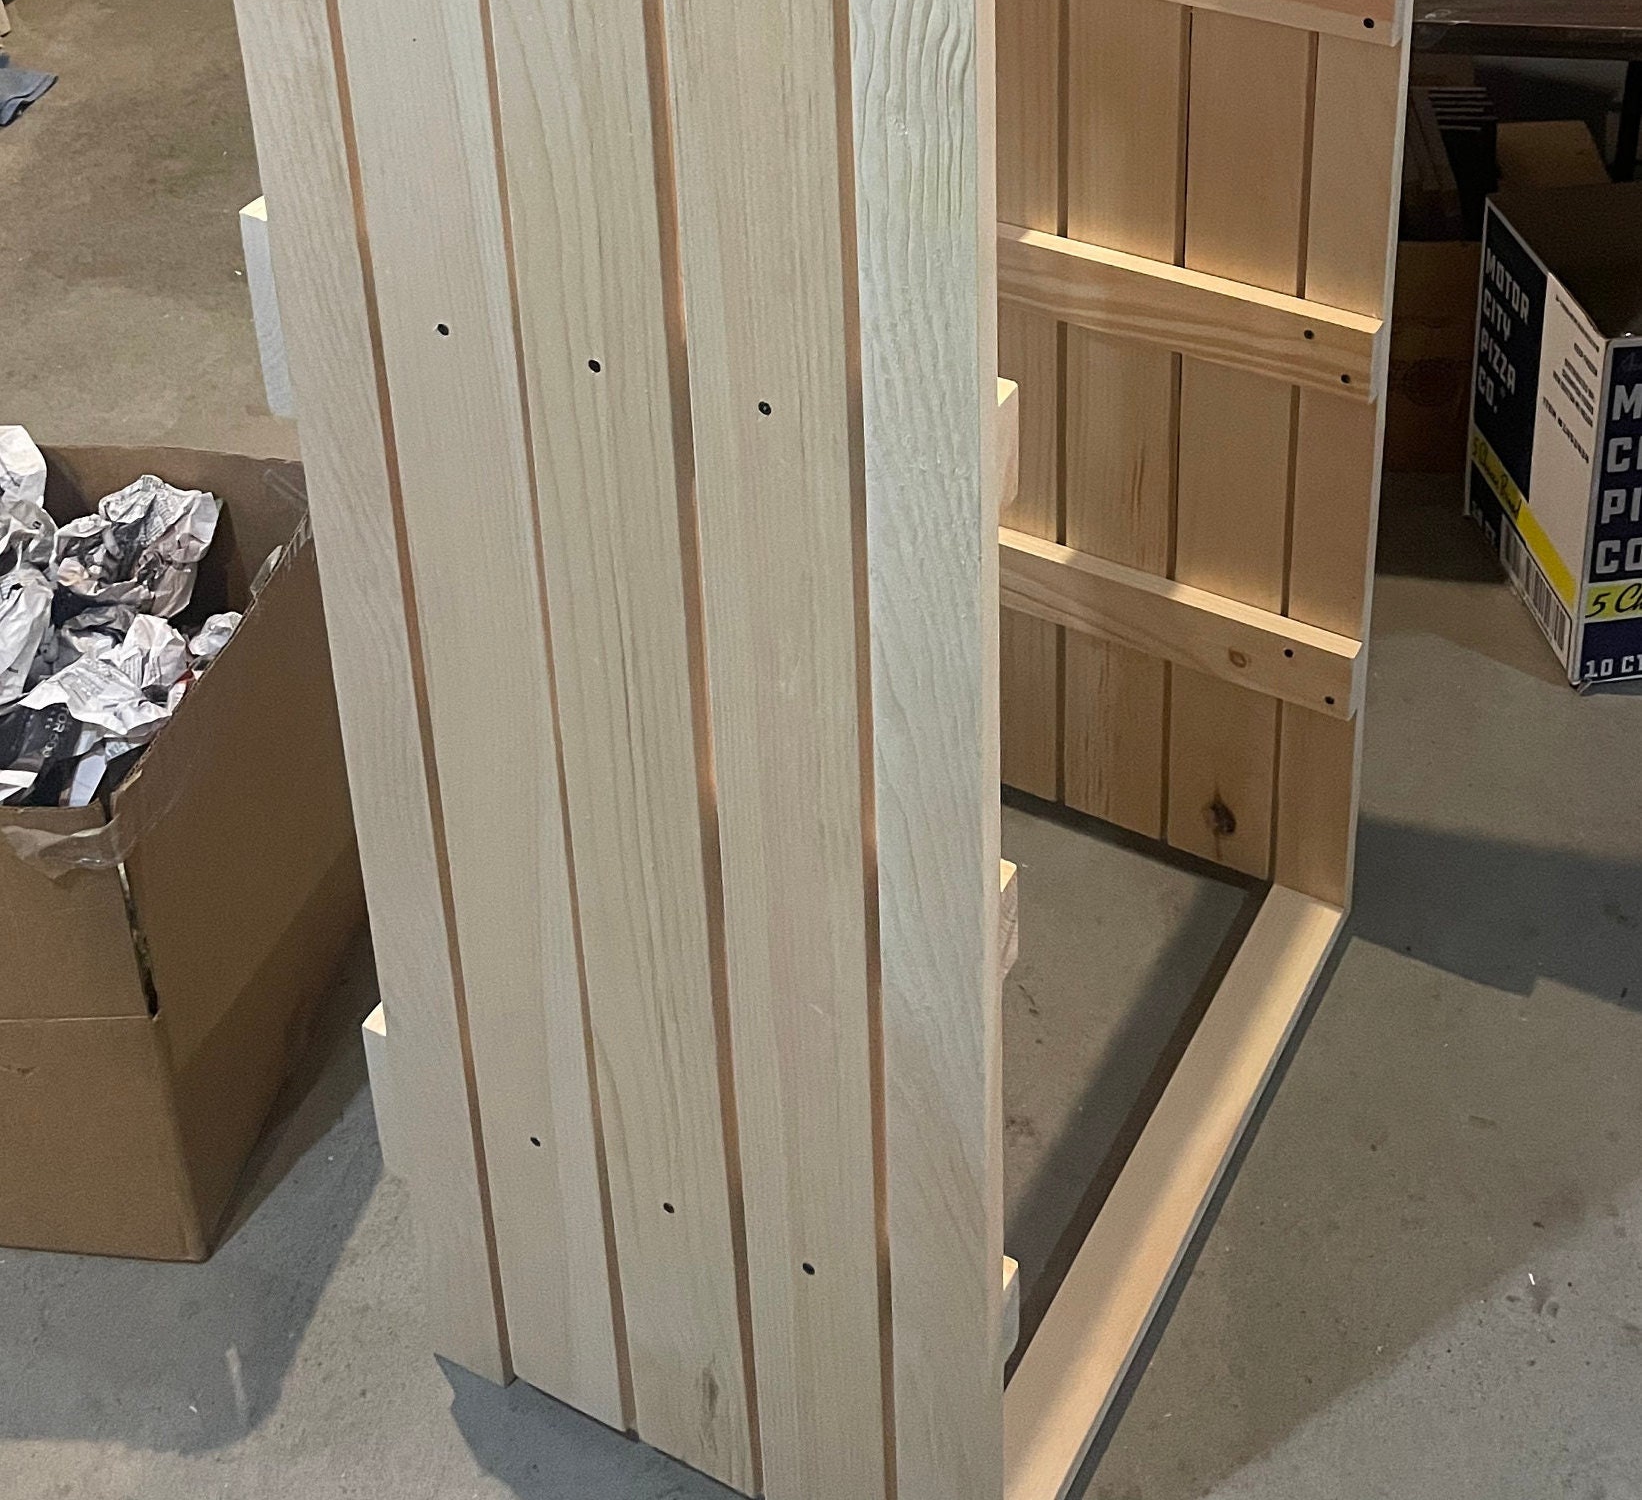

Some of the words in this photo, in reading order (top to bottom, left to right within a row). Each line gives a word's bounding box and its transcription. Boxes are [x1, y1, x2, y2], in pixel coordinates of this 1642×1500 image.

[1485, 247, 1529, 324] MOTOR
[1483, 287, 1511, 342] CITY
[1480, 326, 1516, 396] PIZZA
[1584, 593, 1611, 618] 5
[1583, 658, 1613, 679] 10
